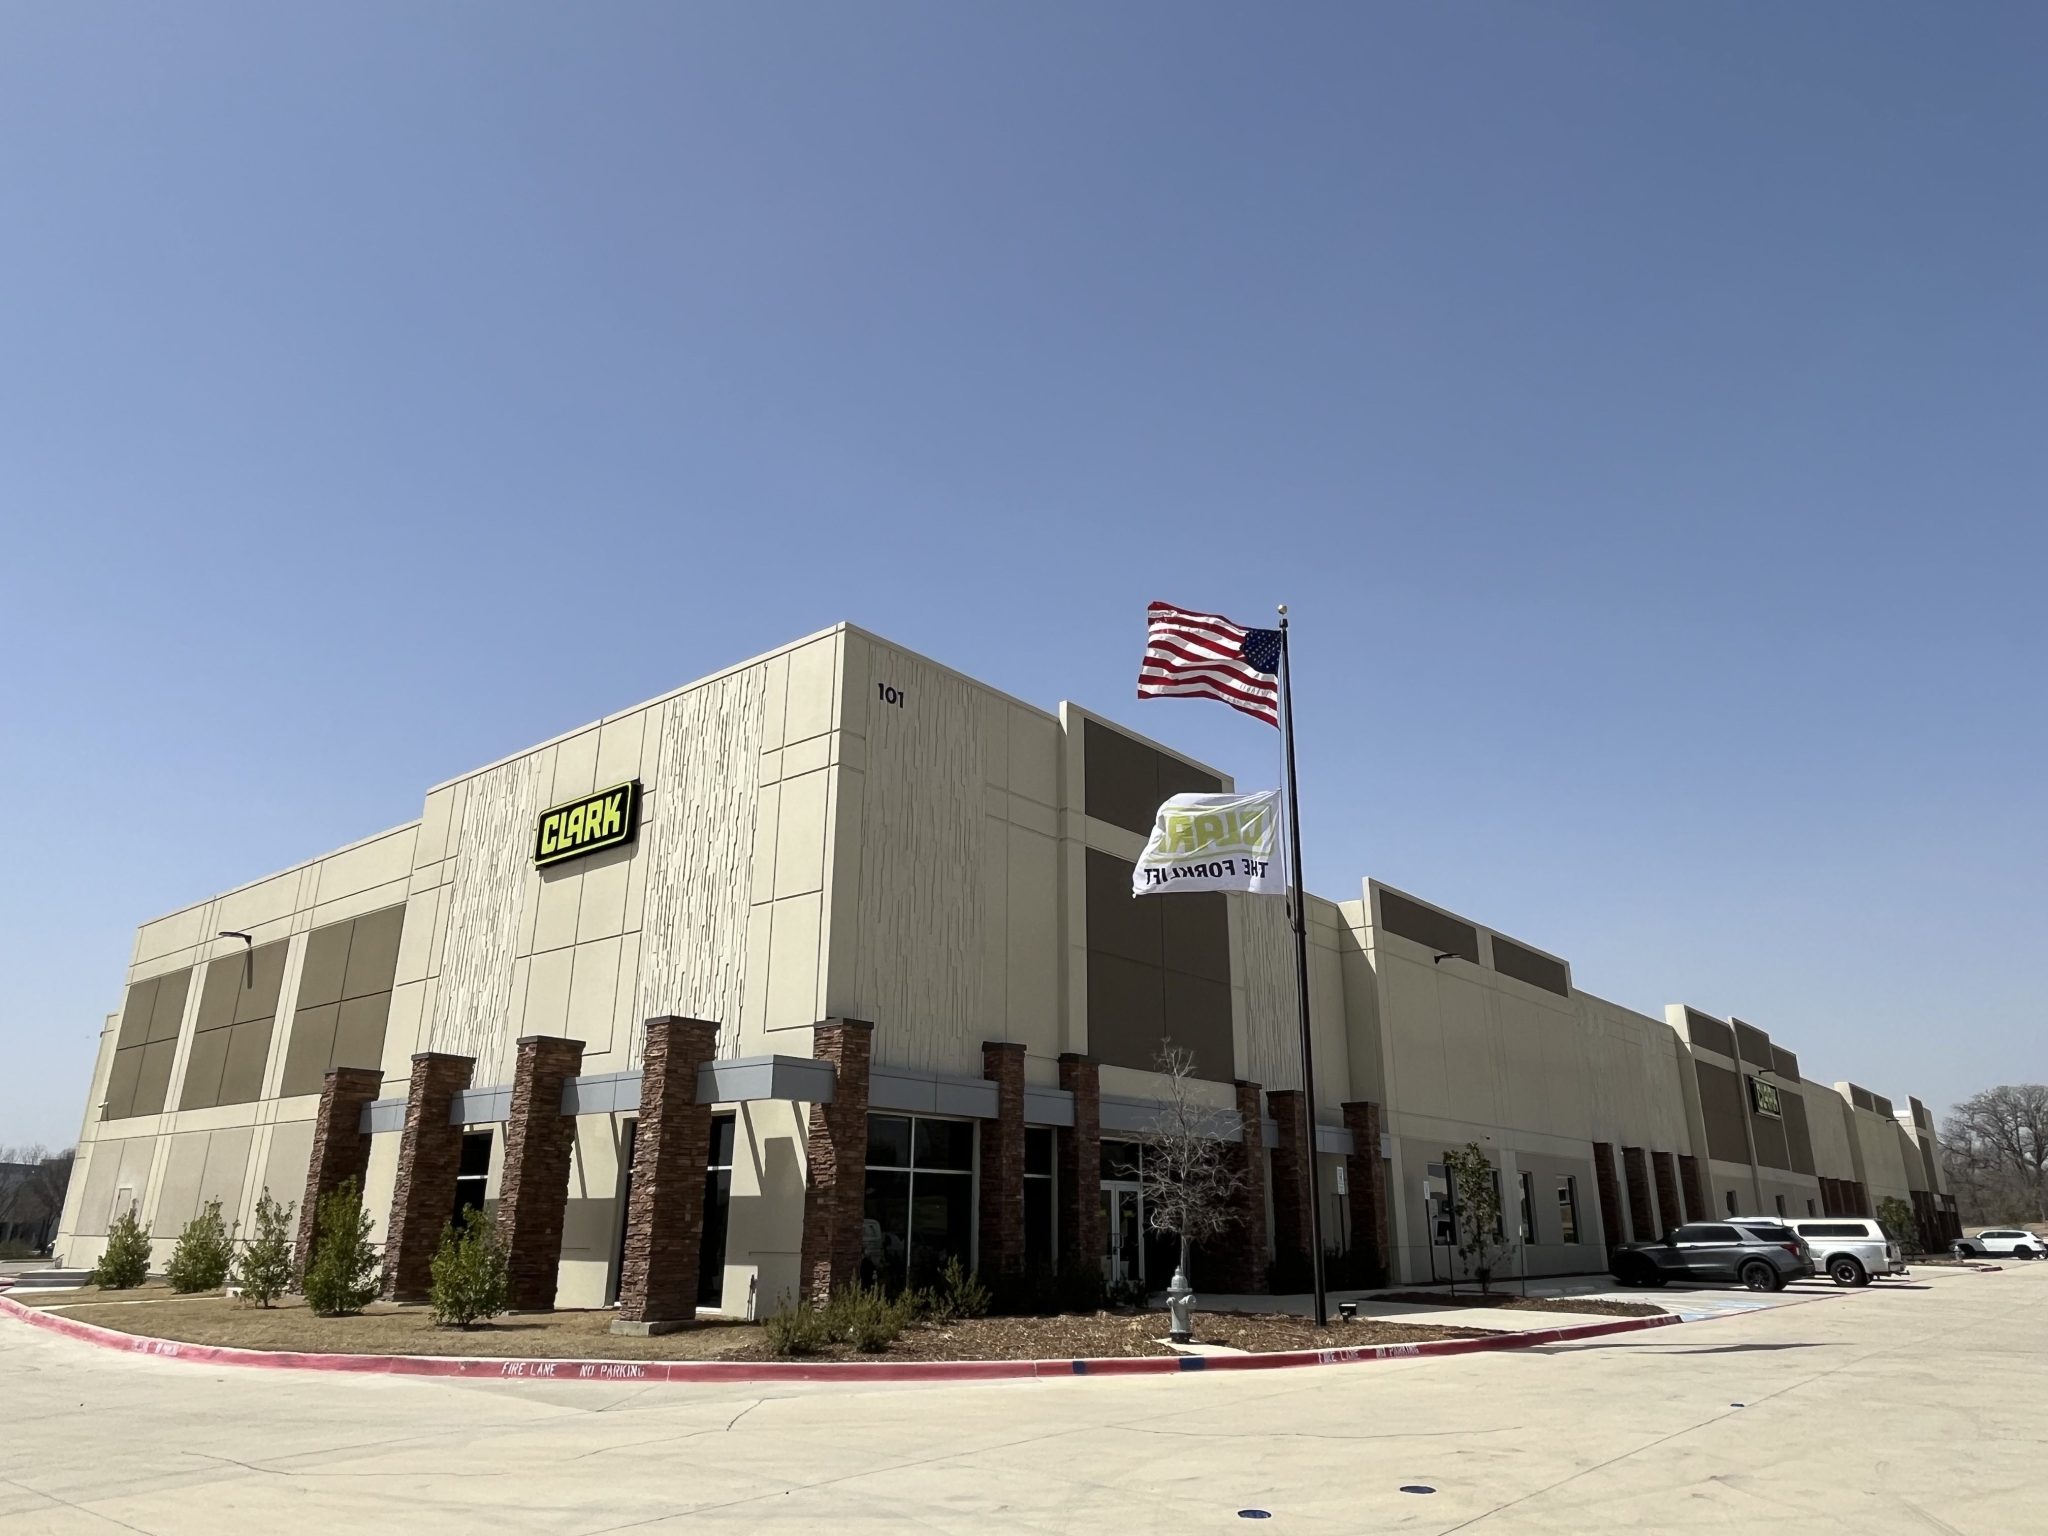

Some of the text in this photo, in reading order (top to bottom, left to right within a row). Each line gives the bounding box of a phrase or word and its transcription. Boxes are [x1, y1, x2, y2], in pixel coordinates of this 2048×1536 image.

[878, 682, 903, 709] 101
[541, 793, 622, 855] CLARK
[501, 1362, 645, 1378] FIRE LANE NO PARKING
